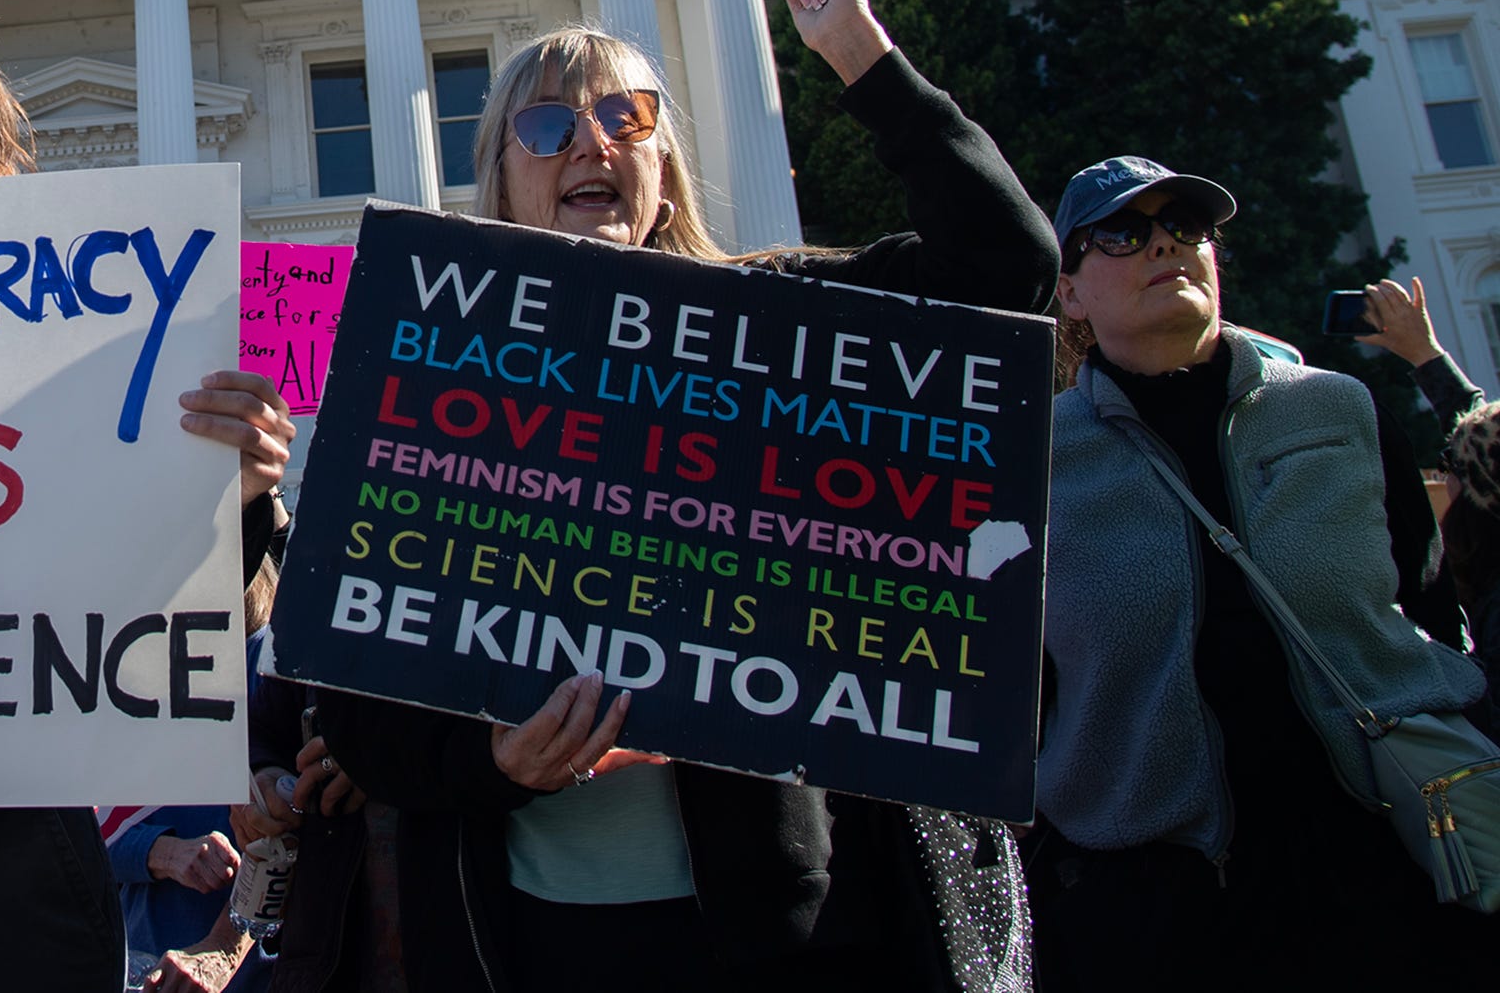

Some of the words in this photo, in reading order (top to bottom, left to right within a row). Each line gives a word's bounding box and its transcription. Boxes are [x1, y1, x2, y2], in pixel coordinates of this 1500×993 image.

[240, 309, 265, 321] ice
[274, 298, 321, 326] for
[241, 250, 290, 297] erty
[289, 257, 334, 284] and
[410, 255, 552, 333] WE
[607, 293, 1001, 413] BELIEVE
[277, 341, 321, 401] AL
[390, 320, 577, 393] BLACK
[597, 358, 741, 422] LIVES
[761, 387, 996, 467] MATTER
[367, 438, 582, 507] FEMINISM
[593, 480, 632, 516] IS
[643, 490, 736, 535] FOR
[748, 509, 964, 578] EVERYON
[377, 375, 604, 462] LOVE
[643, 424, 718, 482] IS
[760, 445, 994, 529] LOVE
[347, 521, 657, 617] SCIENCE
[703, 588, 758, 635] IS
[806, 608, 986, 678] REAL
[358, 482, 420, 516] NO
[435, 497, 594, 550] HUMAN
[609, 530, 740, 577] BEING
[755, 557, 792, 587] IS
[808, 566, 988, 623] ILLEGAL
[330, 574, 437, 647] BE
[454, 599, 666, 690] KIND
[679, 641, 799, 716] TO
[810, 671, 980, 754] ALL
[254, 867, 291, 920] hint
